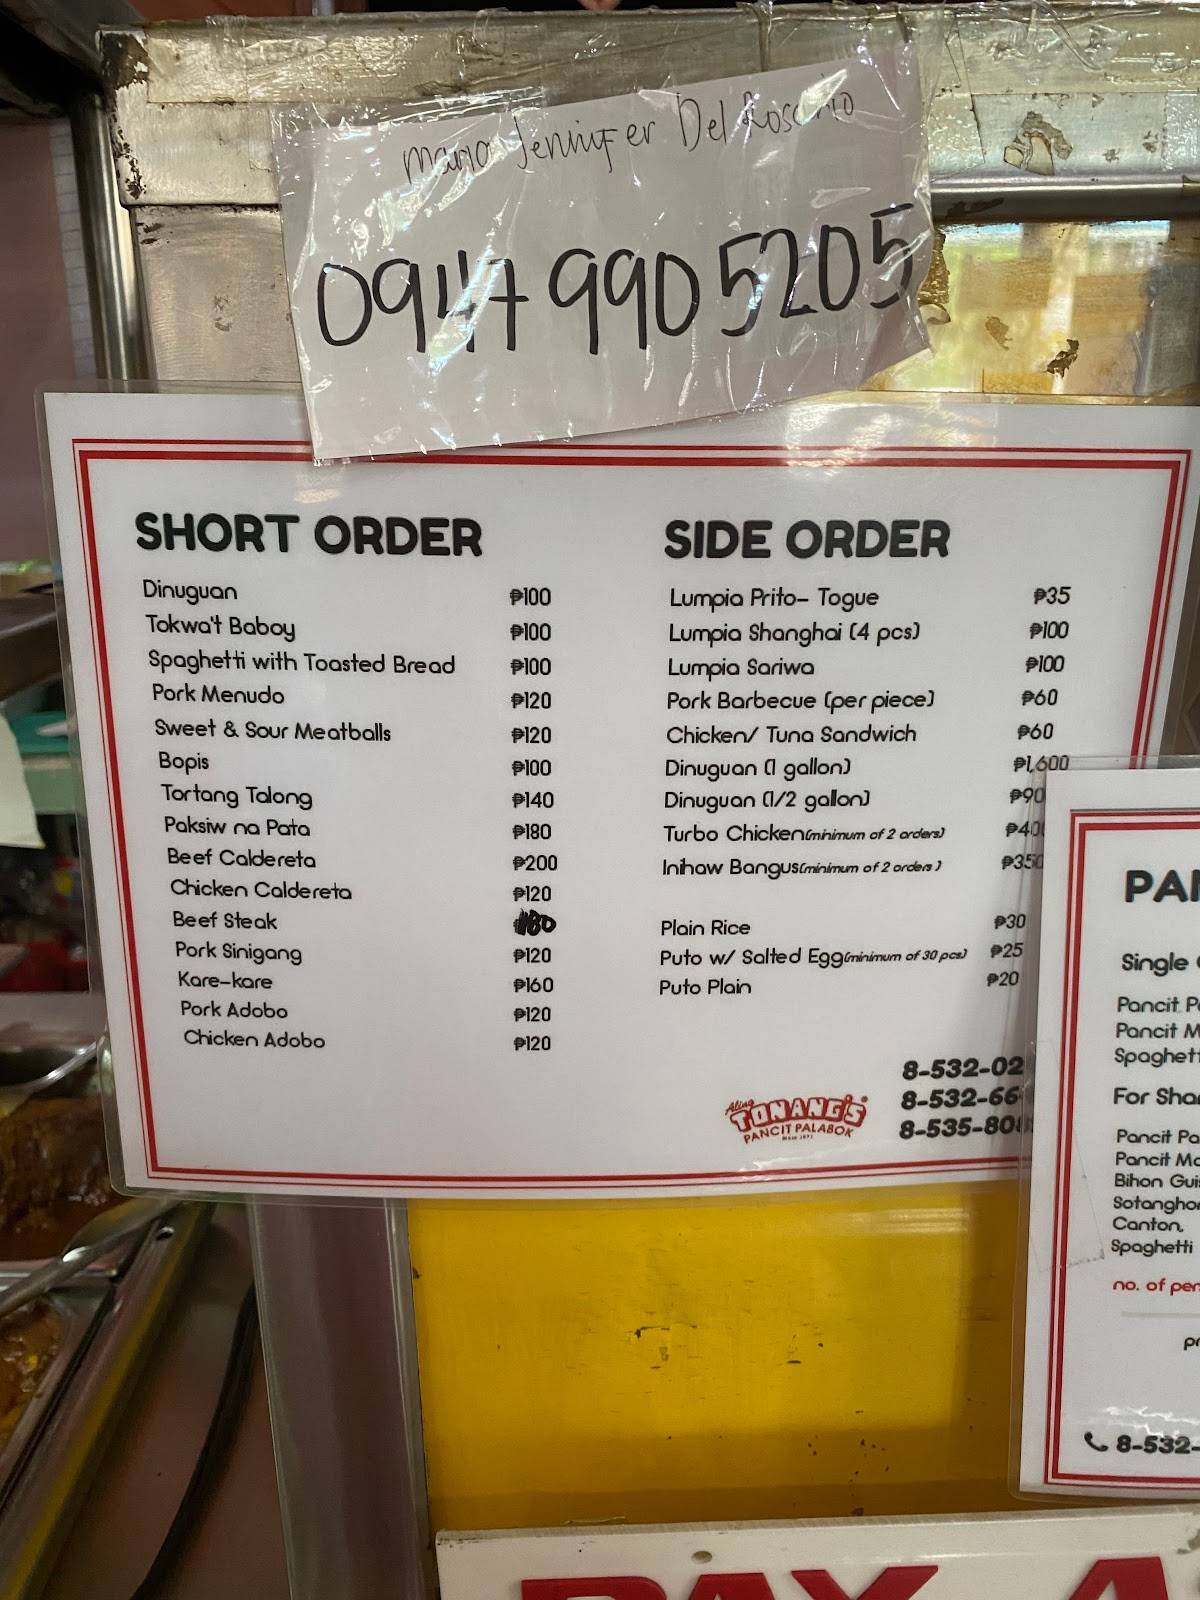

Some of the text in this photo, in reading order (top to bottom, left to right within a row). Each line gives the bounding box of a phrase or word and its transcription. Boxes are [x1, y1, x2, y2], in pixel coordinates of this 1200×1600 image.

[675, 92, 728, 153] Del
[317, 202, 916, 356] 0947 990 5205
[135, 512, 482, 557] SHORT ORDER
[664, 519, 950, 559] SIDE ORDER
[143, 579, 551, 606] Dinuguan ₱100
[671, 588, 743, 613] Lumpia
[818, 587, 879, 612] Togue
[1034, 586, 1071, 605] ₱35
[145, 614, 551, 642] Tokwa't Baboy ₱100
[670, 621, 1069, 648] Lumpia Shanghai (4 pcs) ₱100
[149, 649, 551, 675] Spaghetti with Toasted Bread ₱100
[669, 655, 1065, 682] Lumpia Sariwa ₱100
[153, 683, 551, 709] Pork Menudo ₱120
[668, 689, 1058, 715] Pork Barbecue (per piece) ₱60
[155, 718, 551, 743] Sweet & Sour Meatballs ₱120
[667, 723, 1054, 744] Chicken/ Tuna Sandwich ₱60
[159, 751, 551, 776] Bopis ₱100
[666, 759, 757, 782] Dinuguan
[764, 759, 776, 775] (1
[784, 757, 851, 781] gallon)
[160, 784, 554, 810] Tortang Talong ₱140
[665, 792, 755, 814] Dinuguan
[763, 790, 797, 808] (1/2
[805, 789, 870, 813] gallon)
[165, 816, 551, 840] Paksiw na Pata ₱180
[664, 824, 718, 842] Turbo
[869, 828, 886, 840] of
[886, 828, 896, 840] 2
[899, 827, 946, 840] orders)
[1005, 821, 1045, 837] ₱40
[168, 848, 557, 871] Beef Caldereta ₱200
[663, 858, 724, 875] Inihaw
[863, 862, 880, 873] of
[881, 861, 891, 873] 2
[171, 878, 551, 902] Chicken Caldereta ₱120
[1125, 869, 1200, 903] PA
[173, 911, 218, 928] Beef
[224, 912, 277, 929] Steak
[661, 913, 1026, 936] Plain Rice ₱30
[176, 941, 551, 966] Pork Sinigang ₱120
[660, 949, 702, 966] Puto
[709, 949, 736, 965] w/
[742, 947, 801, 964] Salted
[905, 950, 921, 961] of
[922, 949, 938, 961] 30
[938, 948, 968, 963] pcs)
[990, 943, 1023, 959] ₱25
[1122, 952, 1189, 977] Single
[178, 971, 553, 993] Kare-kare ₱160
[660, 971, 1019, 995] Puto Plain ₱20
[181, 1000, 551, 1022] Pork Adobo ₱120
[1117, 996, 1200, 1013] Pancit P
[184, 1029, 551, 1051] Chicken Adobo ₱120
[1116, 1022, 1178, 1039] Pancit
[901, 1086, 1023, 1111] 8-532-66
[1114, 1087, 1150, 1105] For
[729, 1094, 867, 1132] TONANG'S
[743, 1123, 793, 1144] PANCIT
[795, 1122, 855, 1139] PALABOK
[1117, 1129, 1173, 1144] Pancit
[1116, 1151, 1171, 1166] Pancit
[1115, 1173, 1200, 1188] Bihon Gui
[1113, 1216, 1184, 1232] Canton,
[1111, 1239, 1193, 1257] Spaghetti
[1113, 1280, 1140, 1292] no.
[1146, 1277, 1167, 1292] of
